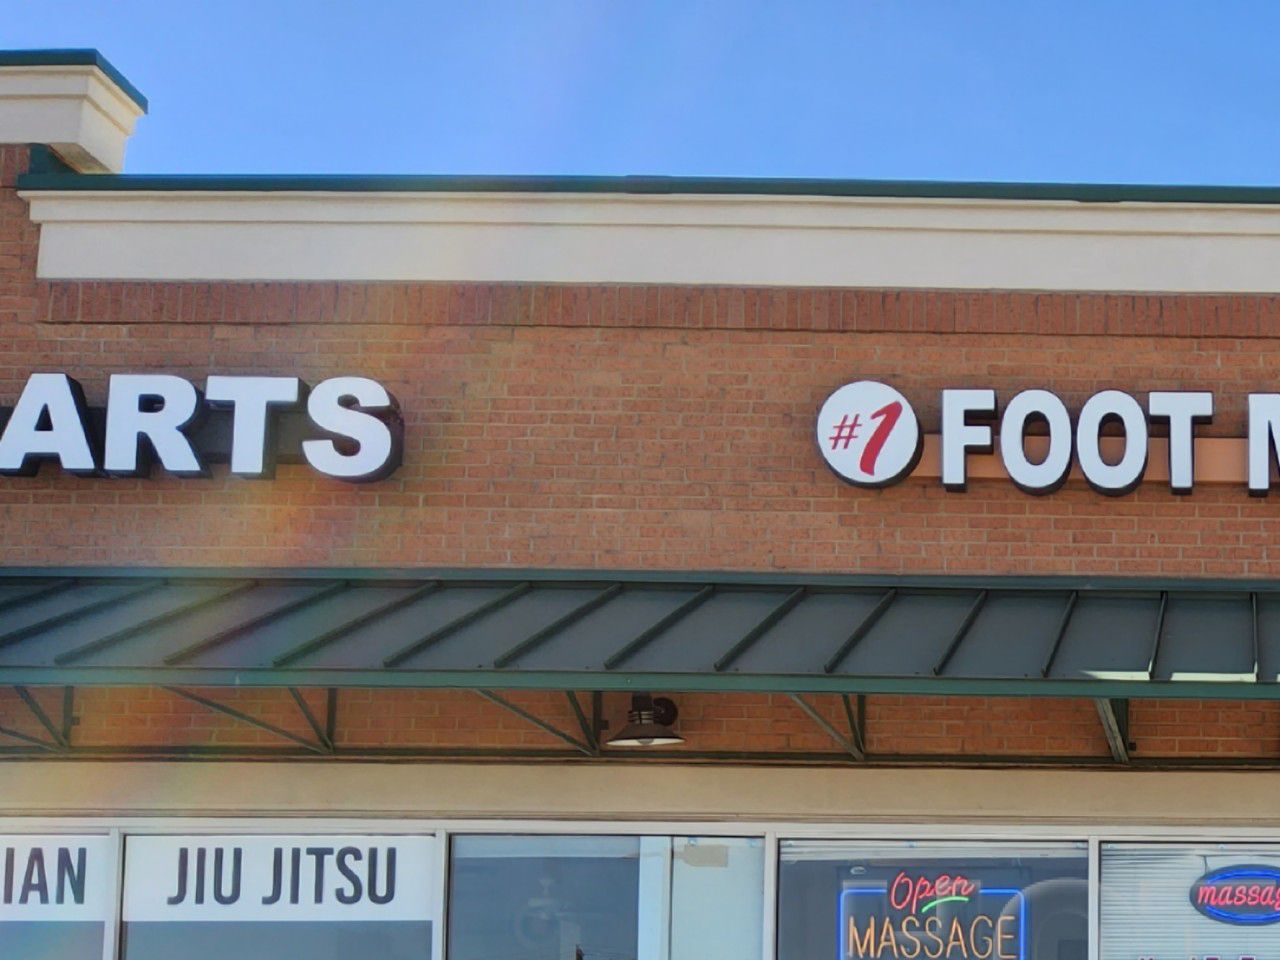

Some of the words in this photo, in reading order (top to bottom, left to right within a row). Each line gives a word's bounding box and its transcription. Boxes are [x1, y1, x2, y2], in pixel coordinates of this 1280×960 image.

[0, 373, 396, 479] ARTS
[828, 401, 903, 476] #1
[941, 388, 1214, 492] FOOT
[3, 846, 88, 905] IAN
[167, 846, 243, 906] JIU
[261, 846, 398, 906] JITSU
[889, 871, 977, 915] Open
[848, 915, 1018, 960] MASSAGE
